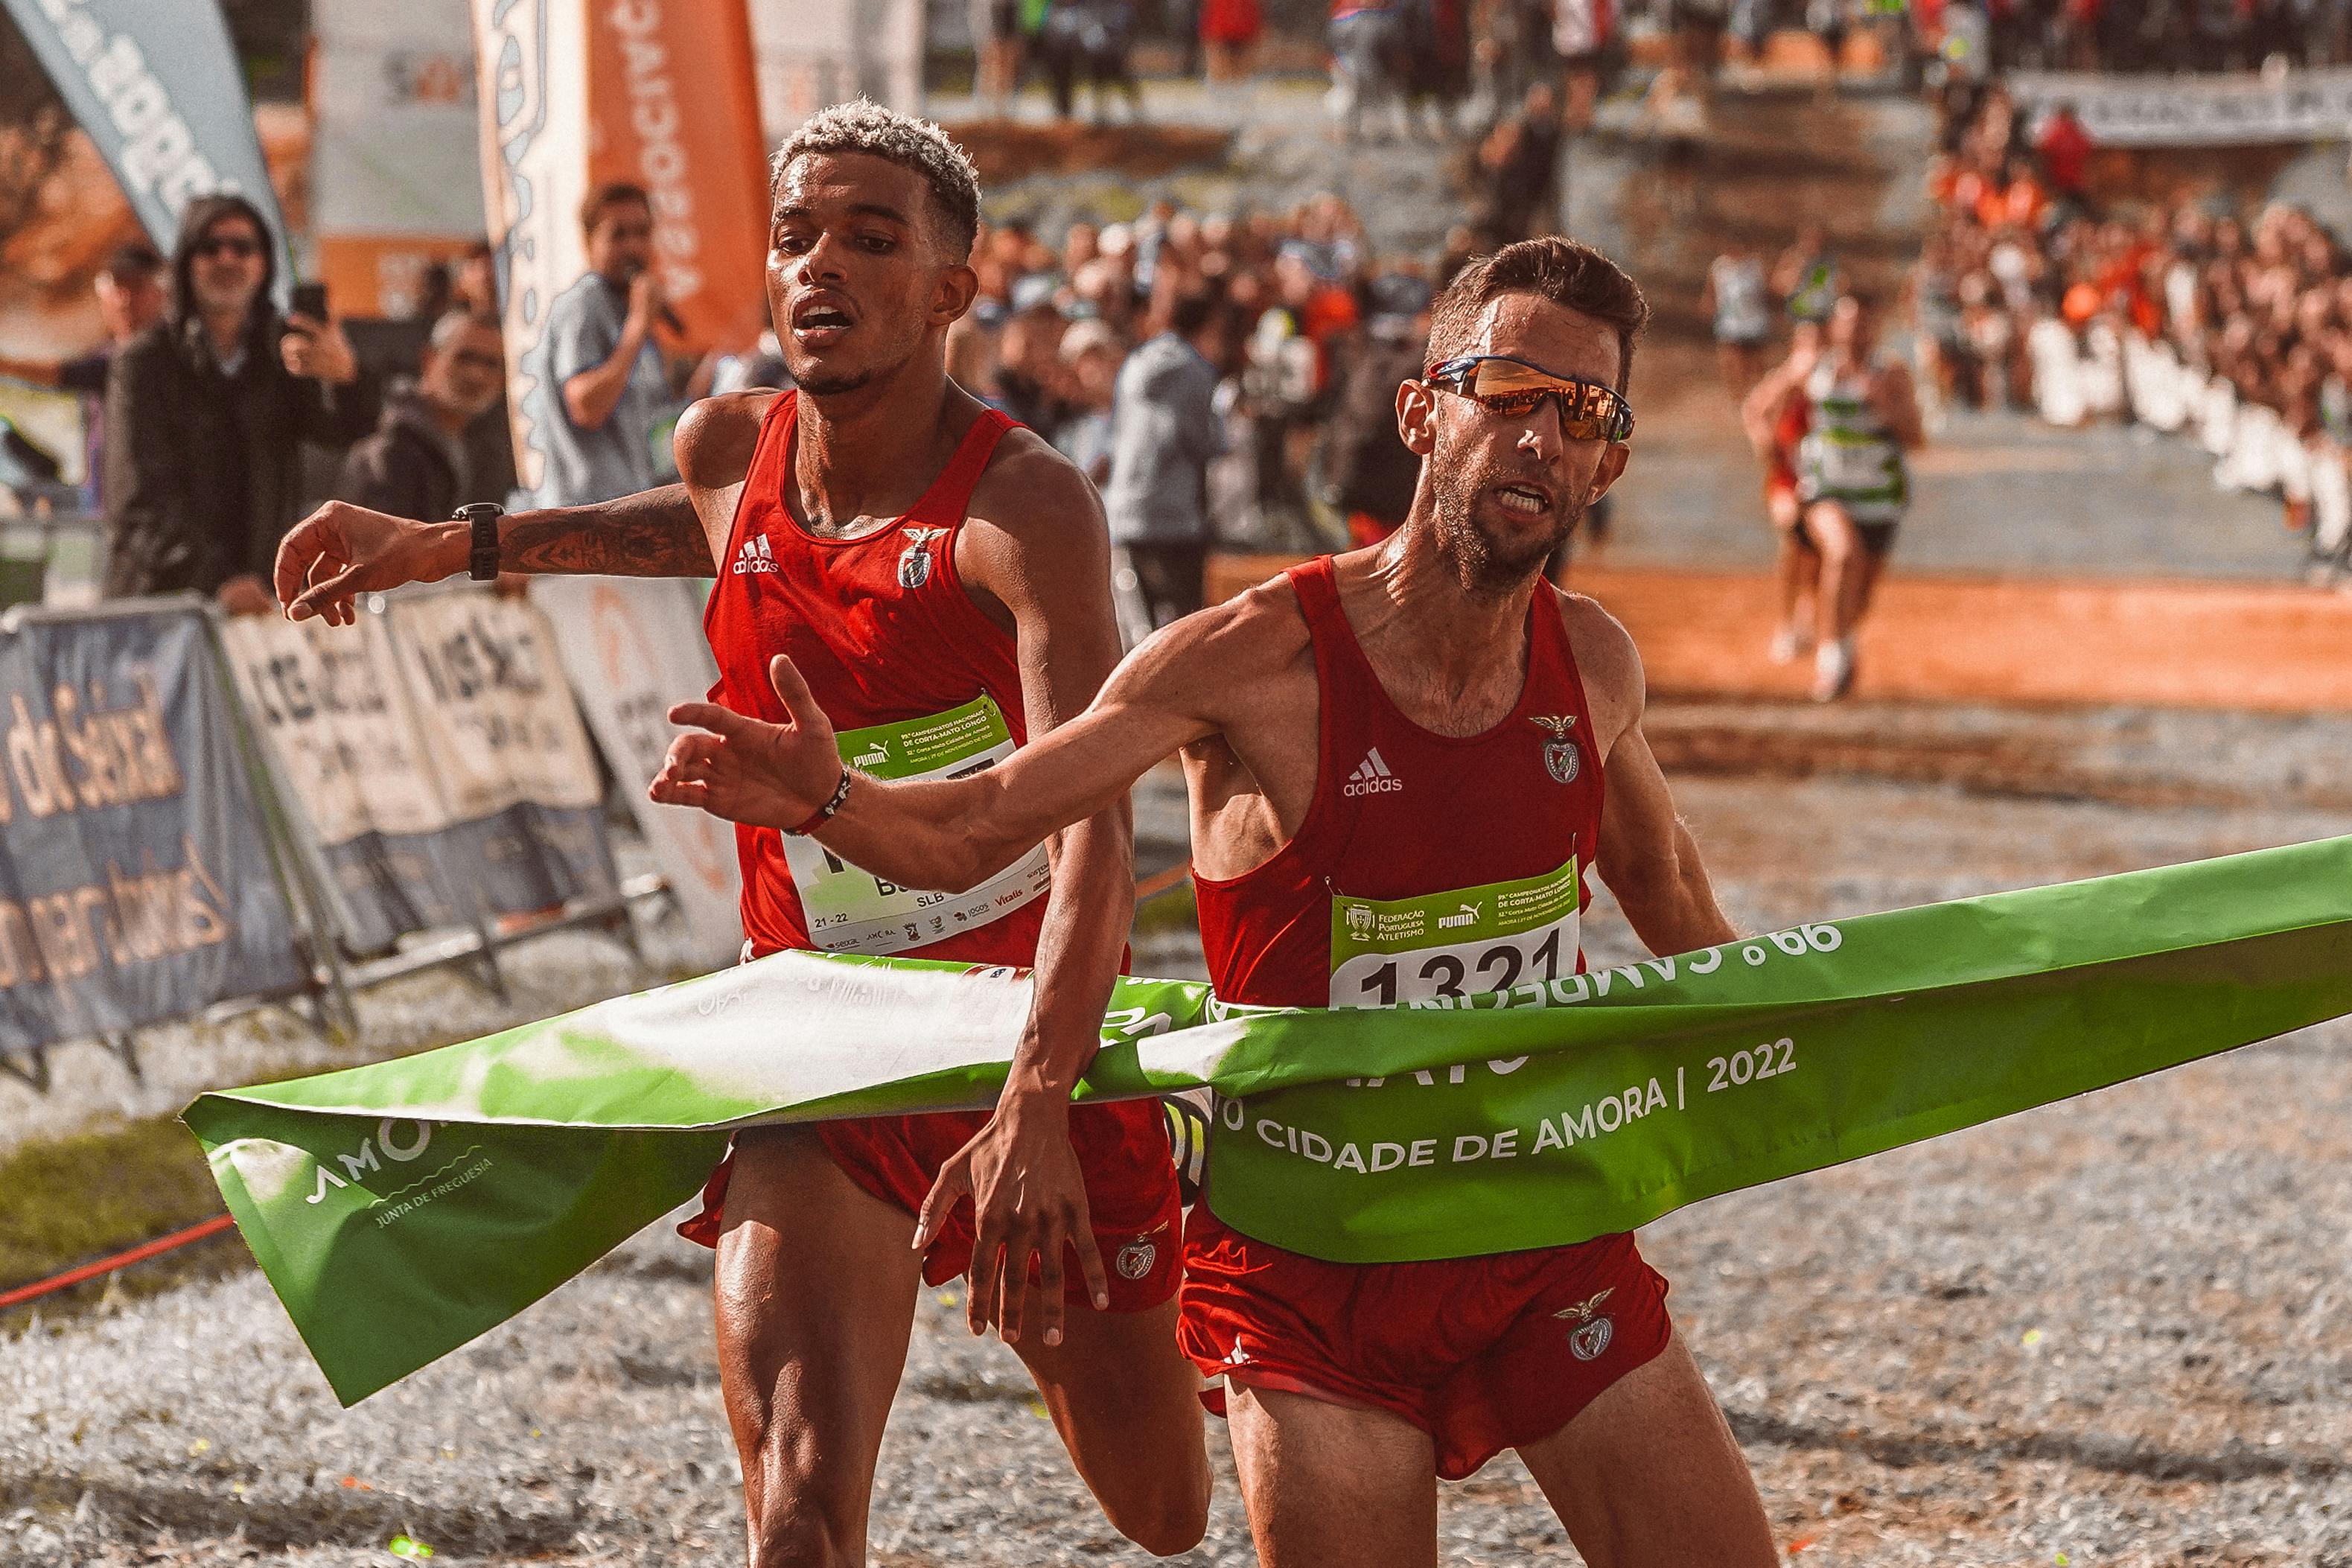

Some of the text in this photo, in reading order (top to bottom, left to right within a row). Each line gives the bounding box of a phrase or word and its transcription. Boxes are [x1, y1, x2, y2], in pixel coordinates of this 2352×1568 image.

[733, 556, 779, 575] adidas
[914, 727, 960, 745] CORTA-MATO
[961, 716, 987, 730] LONGO
[853, 752, 886, 768] PUMA
[1343, 777, 1403, 797] adidas
[916, 892, 945, 908] SLB
[995, 889, 1023, 907] Vitalis
[1498, 900, 1508, 908] DE
[968, 903, 989, 917] JOGOS
[1379, 910, 1425, 922] FEDERAÇÃO
[815, 917, 826, 928] 21
[835, 913, 849, 923] 22
[1379, 920, 1425, 932] PORTUGUESA
[1438, 913, 1476, 929] PUMA
[1377, 928, 1424, 941] ATLETISMO
[1360, 926, 1561, 1006] 1321
[1256, 1118, 1437, 1174] CIDADE
[1452, 1128, 1518, 1162] DE
[1531, 1077, 1668, 1155] AMORA
[1706, 1038, 1797, 1093] 2022
[306, 1118, 447, 1205] AMO
[375, 1156, 494, 1228] JUNTA DE FREGUESIA
